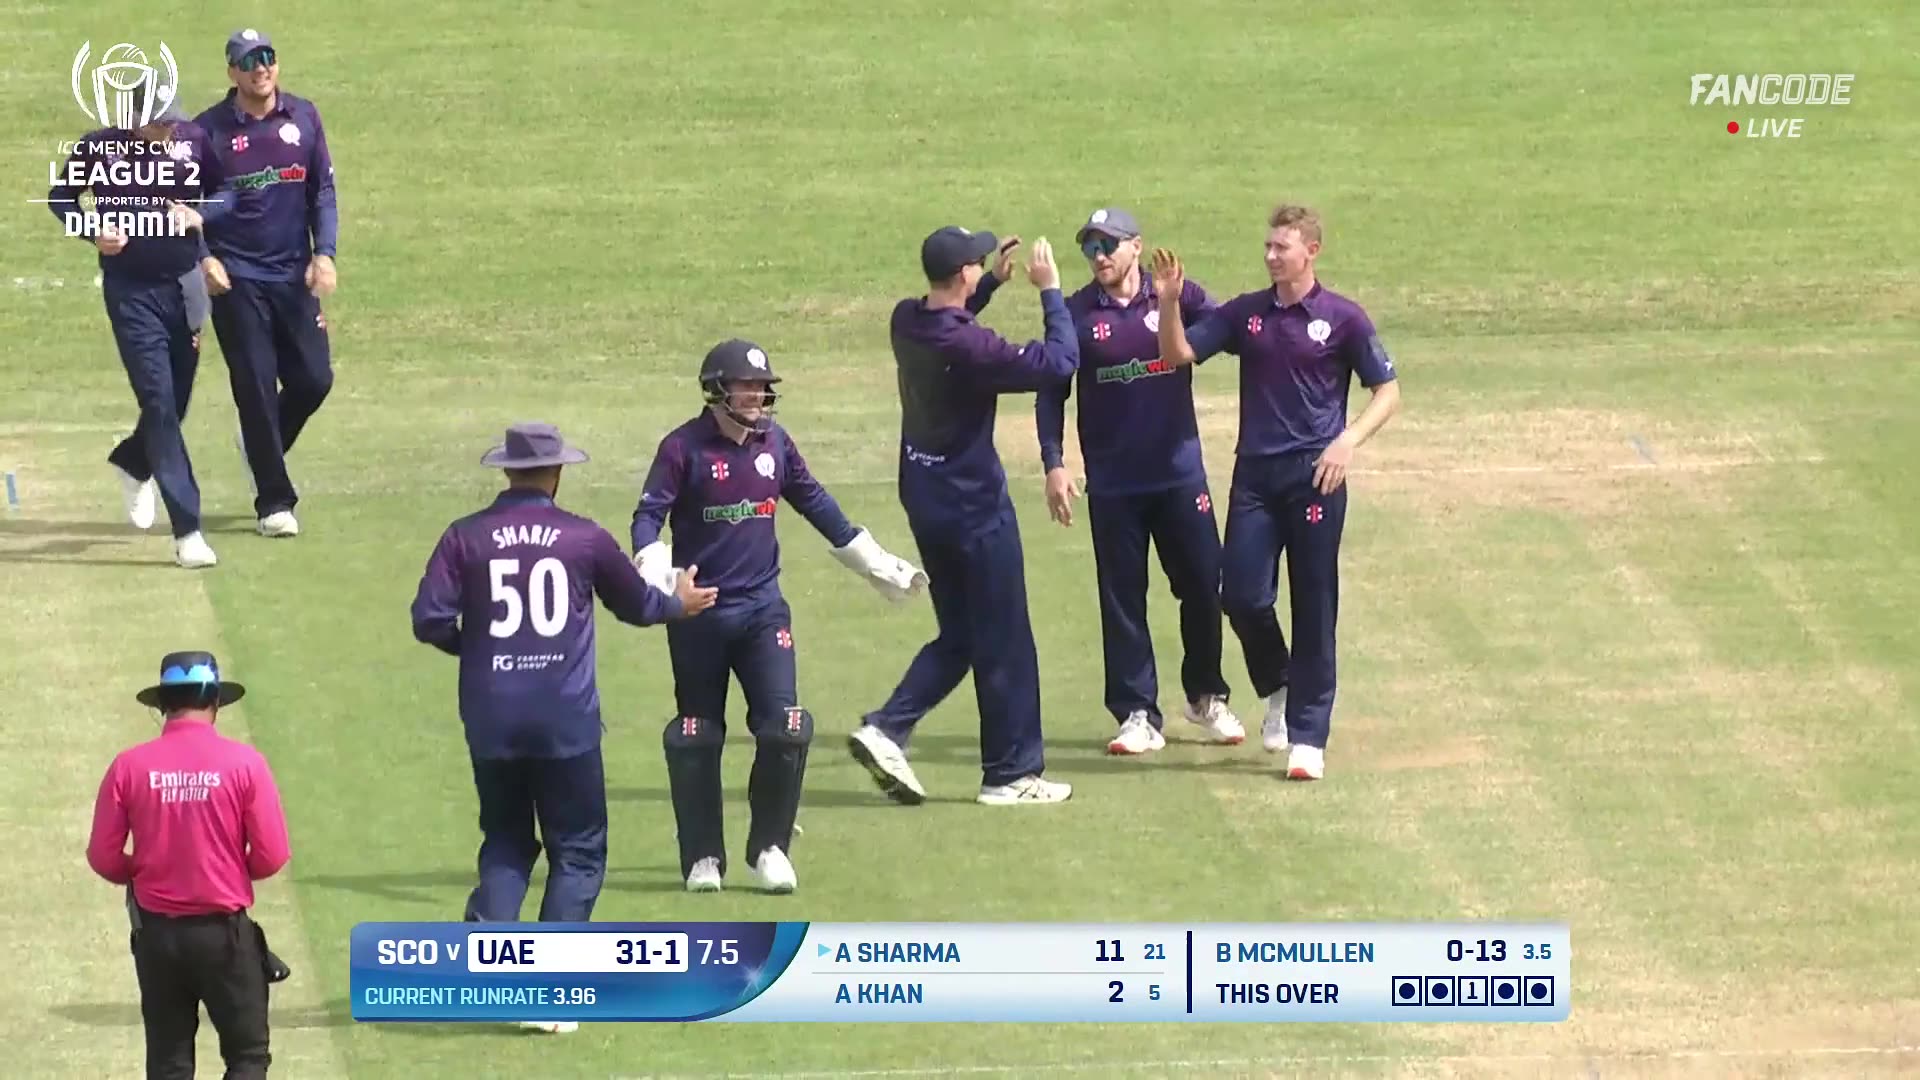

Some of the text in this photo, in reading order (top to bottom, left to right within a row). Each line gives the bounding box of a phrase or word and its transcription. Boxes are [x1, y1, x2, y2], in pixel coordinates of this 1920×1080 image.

[492, 524, 562, 549] SHARIF
[489, 557, 569, 638] 50
[149, 770, 221, 789] Emirates
[161, 789, 178, 803] FLY
